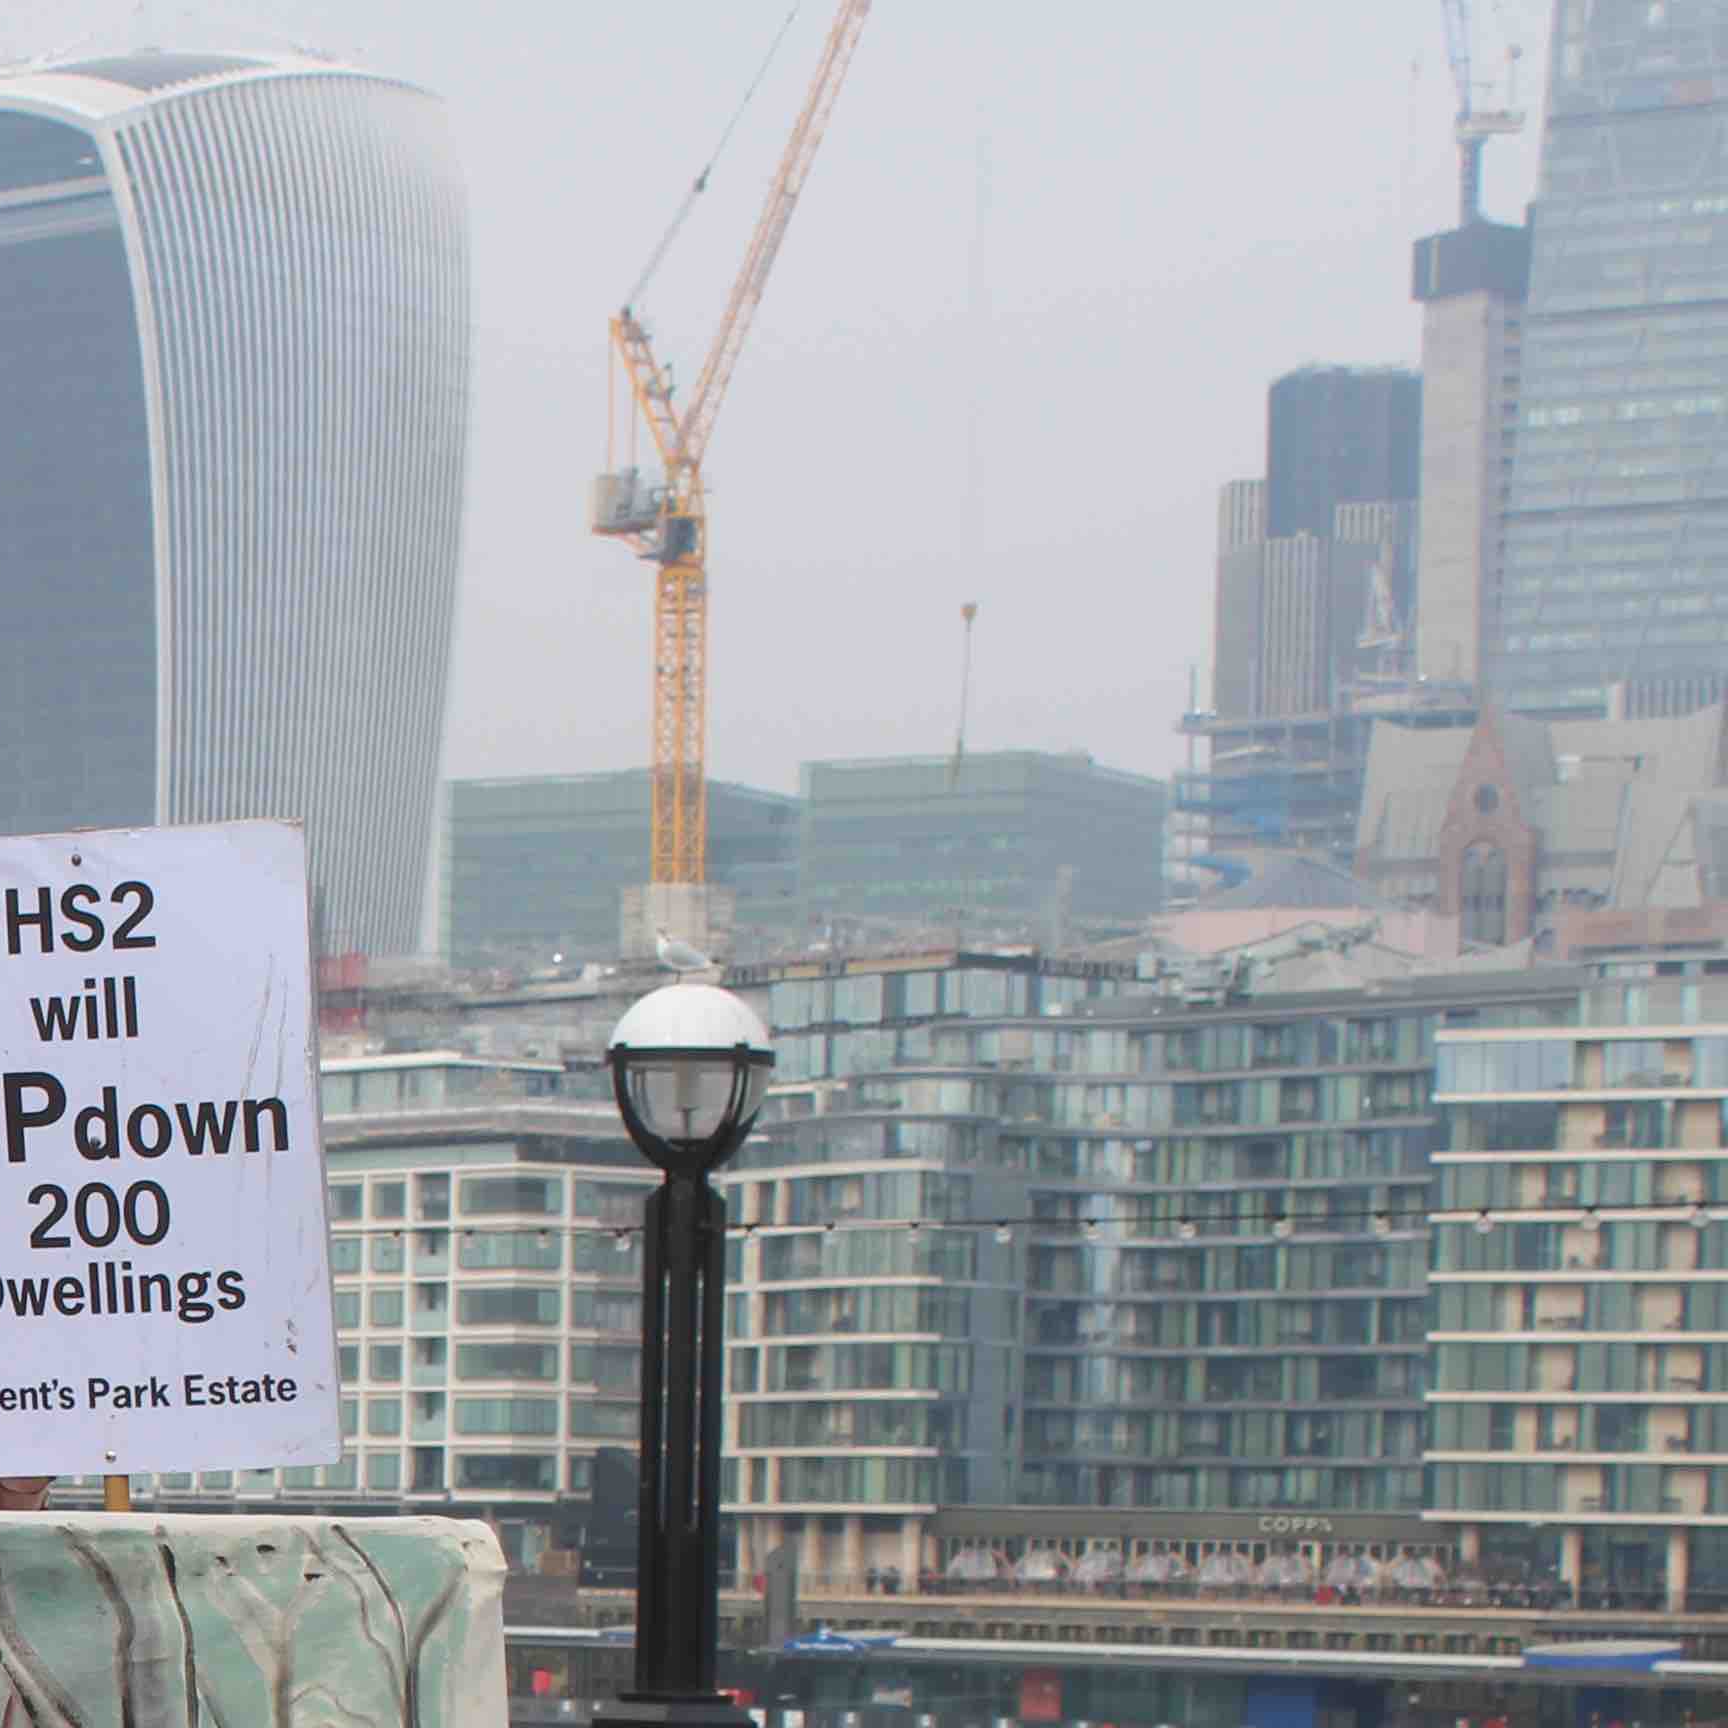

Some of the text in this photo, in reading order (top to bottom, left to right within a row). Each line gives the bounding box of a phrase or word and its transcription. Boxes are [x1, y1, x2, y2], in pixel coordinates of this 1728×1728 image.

[4, 880, 157, 955] HS2
[29, 976, 138, 1042] will
[27, 1180, 171, 1249] 200
[87, 1374, 170, 1409] Park
[184, 1371, 298, 1405] Estate
